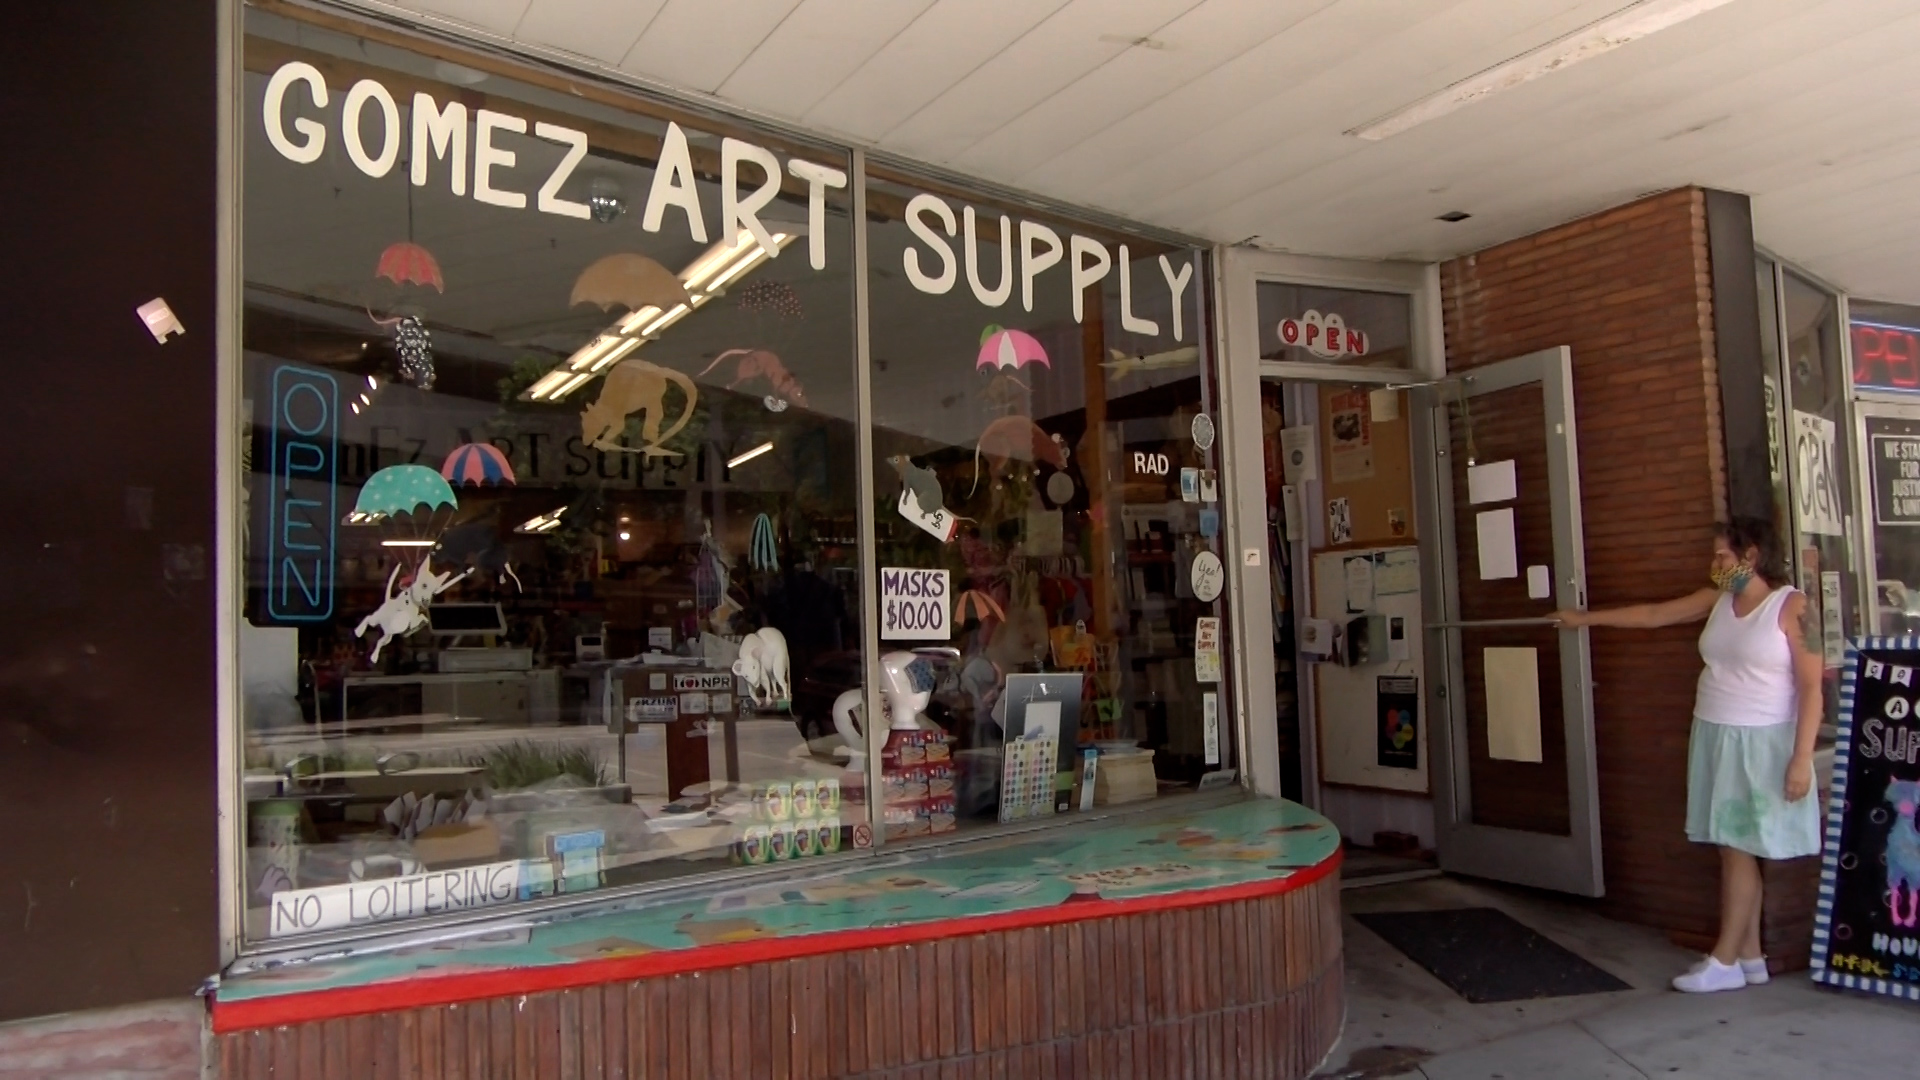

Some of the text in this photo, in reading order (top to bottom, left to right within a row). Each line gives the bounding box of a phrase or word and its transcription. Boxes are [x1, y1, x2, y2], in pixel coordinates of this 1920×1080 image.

[263, 62, 1193, 341] GOMEZ ART SUPPLY
[1282, 319, 1364, 355] OPEN
[1133, 451, 1170, 476] RAD
[1884, 441, 1900, 459] WE
[282, 382, 328, 608] OPEN
[883, 571, 945, 598] MASKS
[886, 599, 943, 632] $10.00
[701, 677, 730, 688] NPR
[275, 863, 513, 933] NO LOITERING
[1872, 932, 1920, 957] HOU
